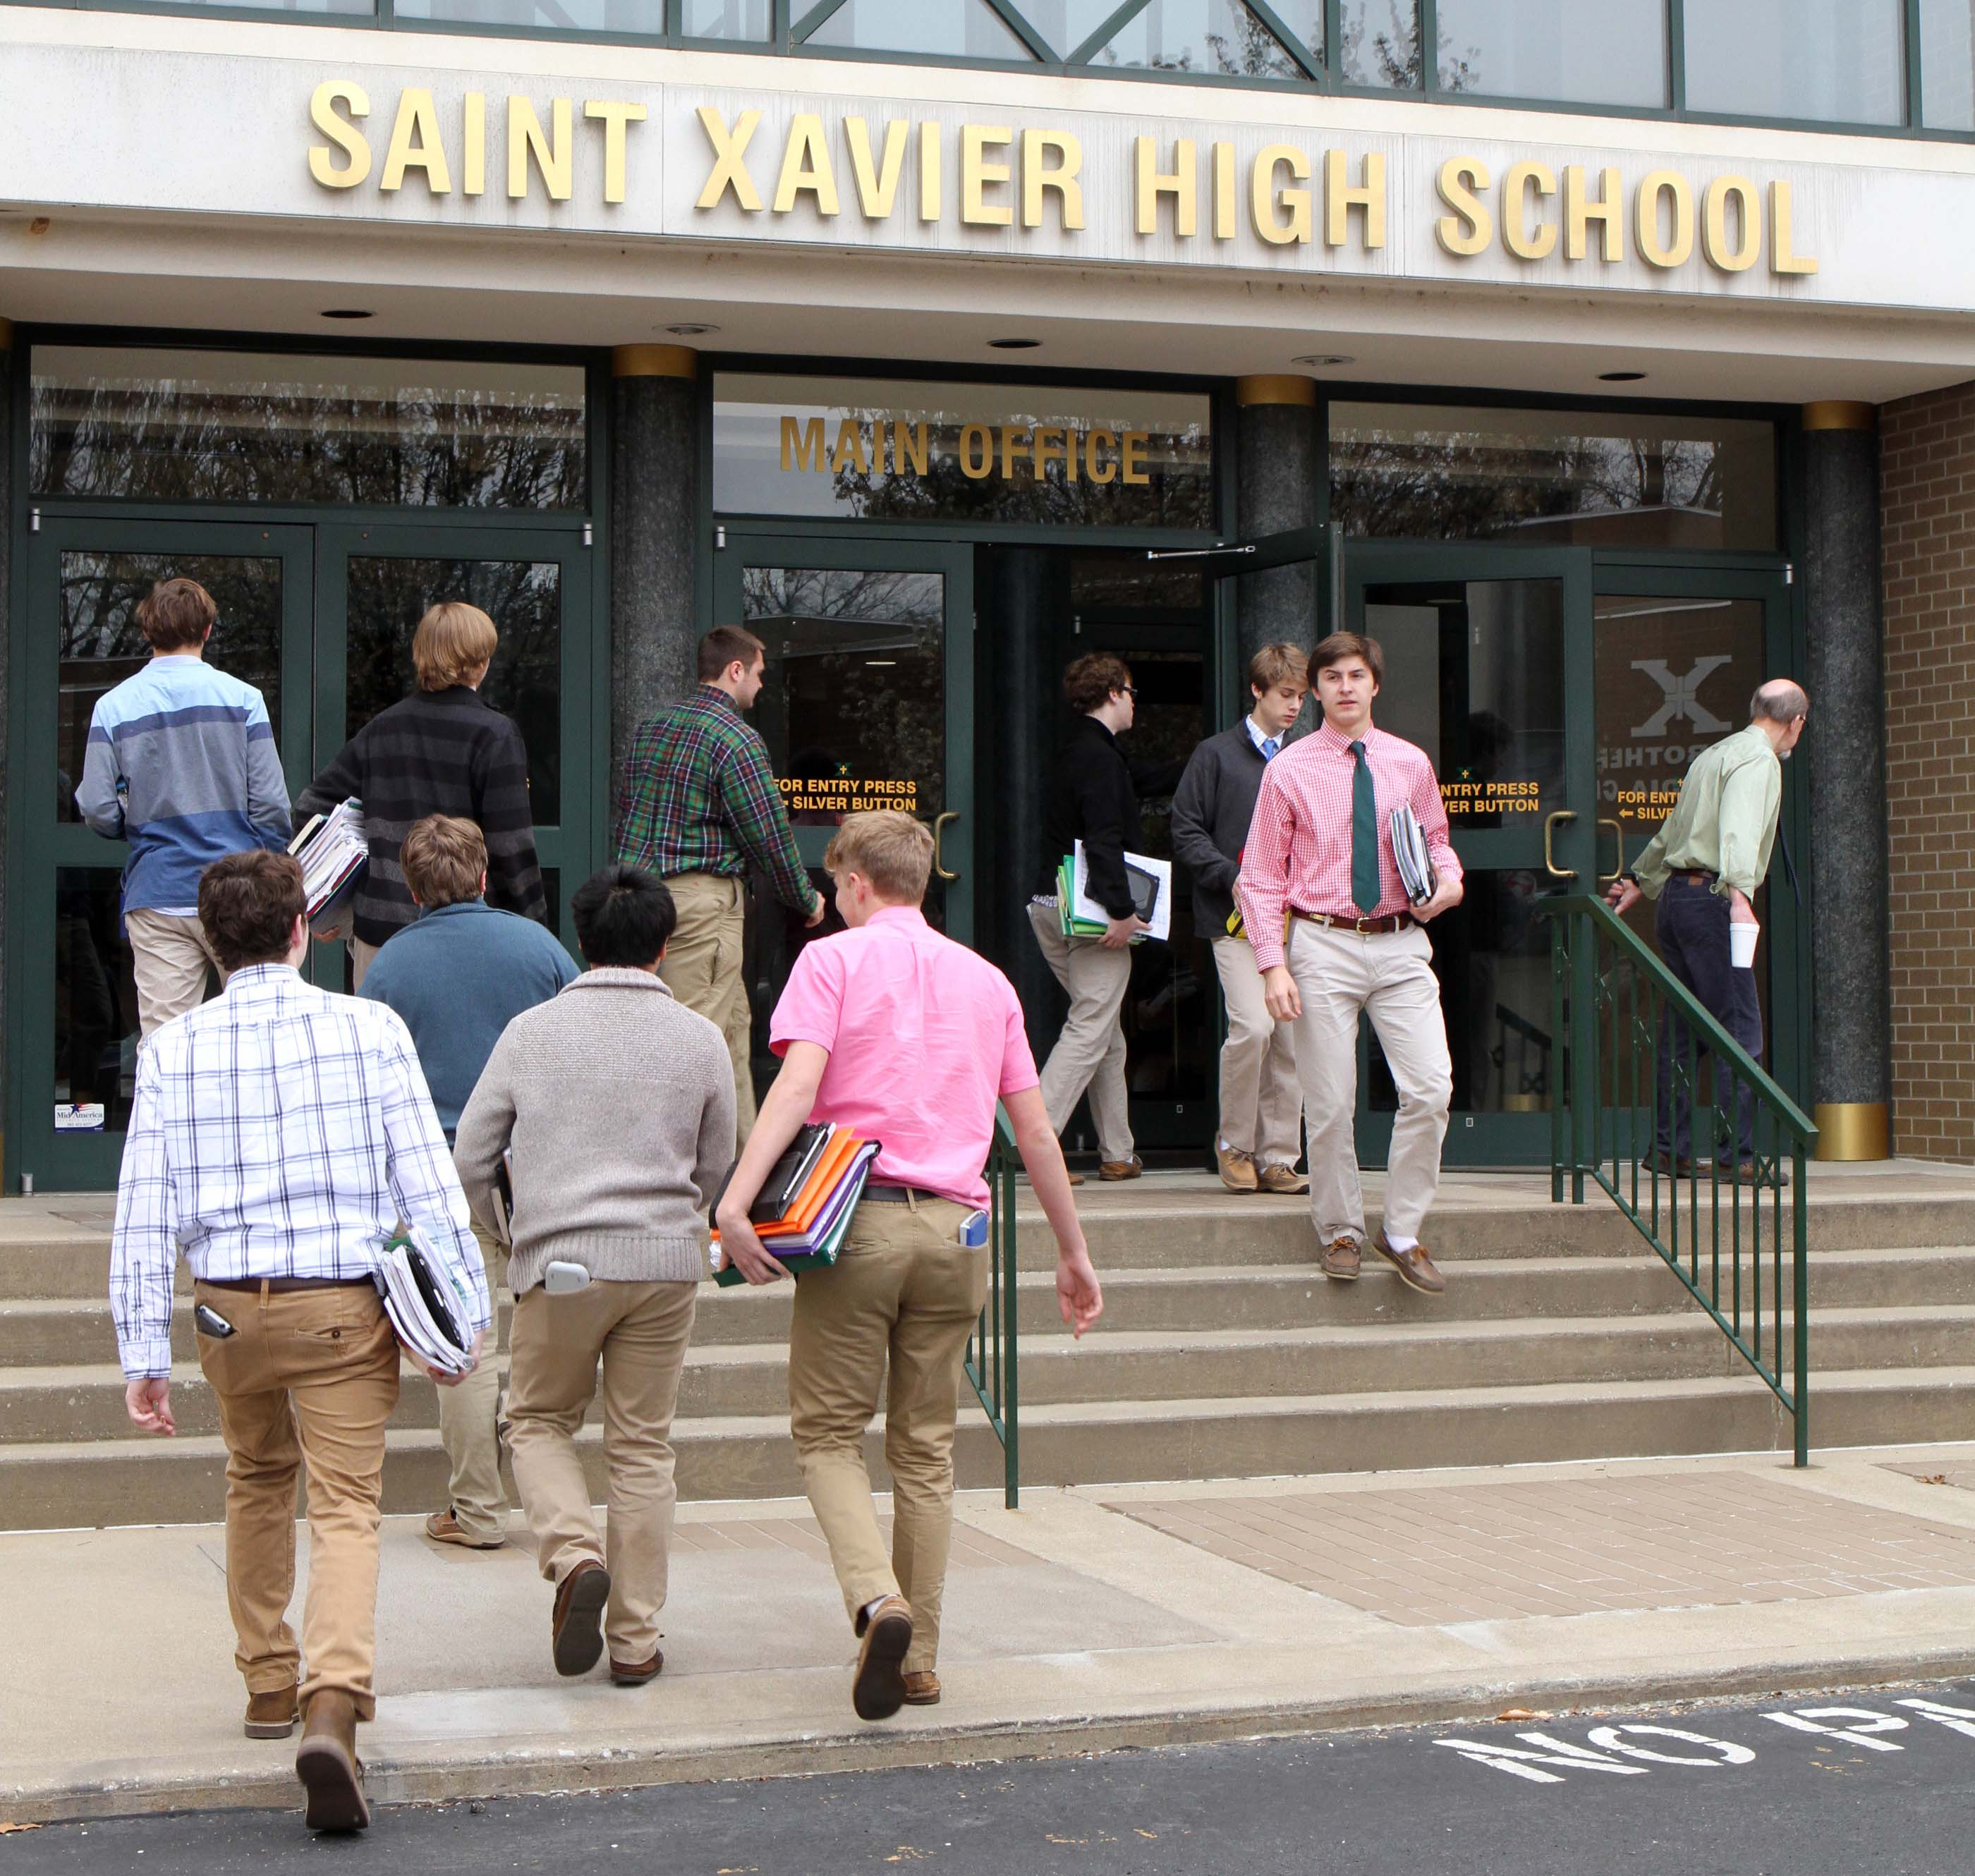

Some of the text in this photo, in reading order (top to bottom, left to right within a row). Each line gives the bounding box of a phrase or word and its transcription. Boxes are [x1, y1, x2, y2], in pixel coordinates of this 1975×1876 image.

[308, 80, 1818, 275] SAINT XAVIER HIGH SCHOOL
[780, 416, 1150, 485] MAIN OFFICE
[808, 779, 860, 793] ENTRY
[864, 780, 916, 794] PRESS
[1438, 782, 1539, 796] NTRY PRESS
[793, 796, 916, 811] SILVER BUTTON
[1618, 791, 1646, 803] FOR
[1474, 798, 1539, 813] BUTTON
[1432, 1724, 1756, 1783] NO
